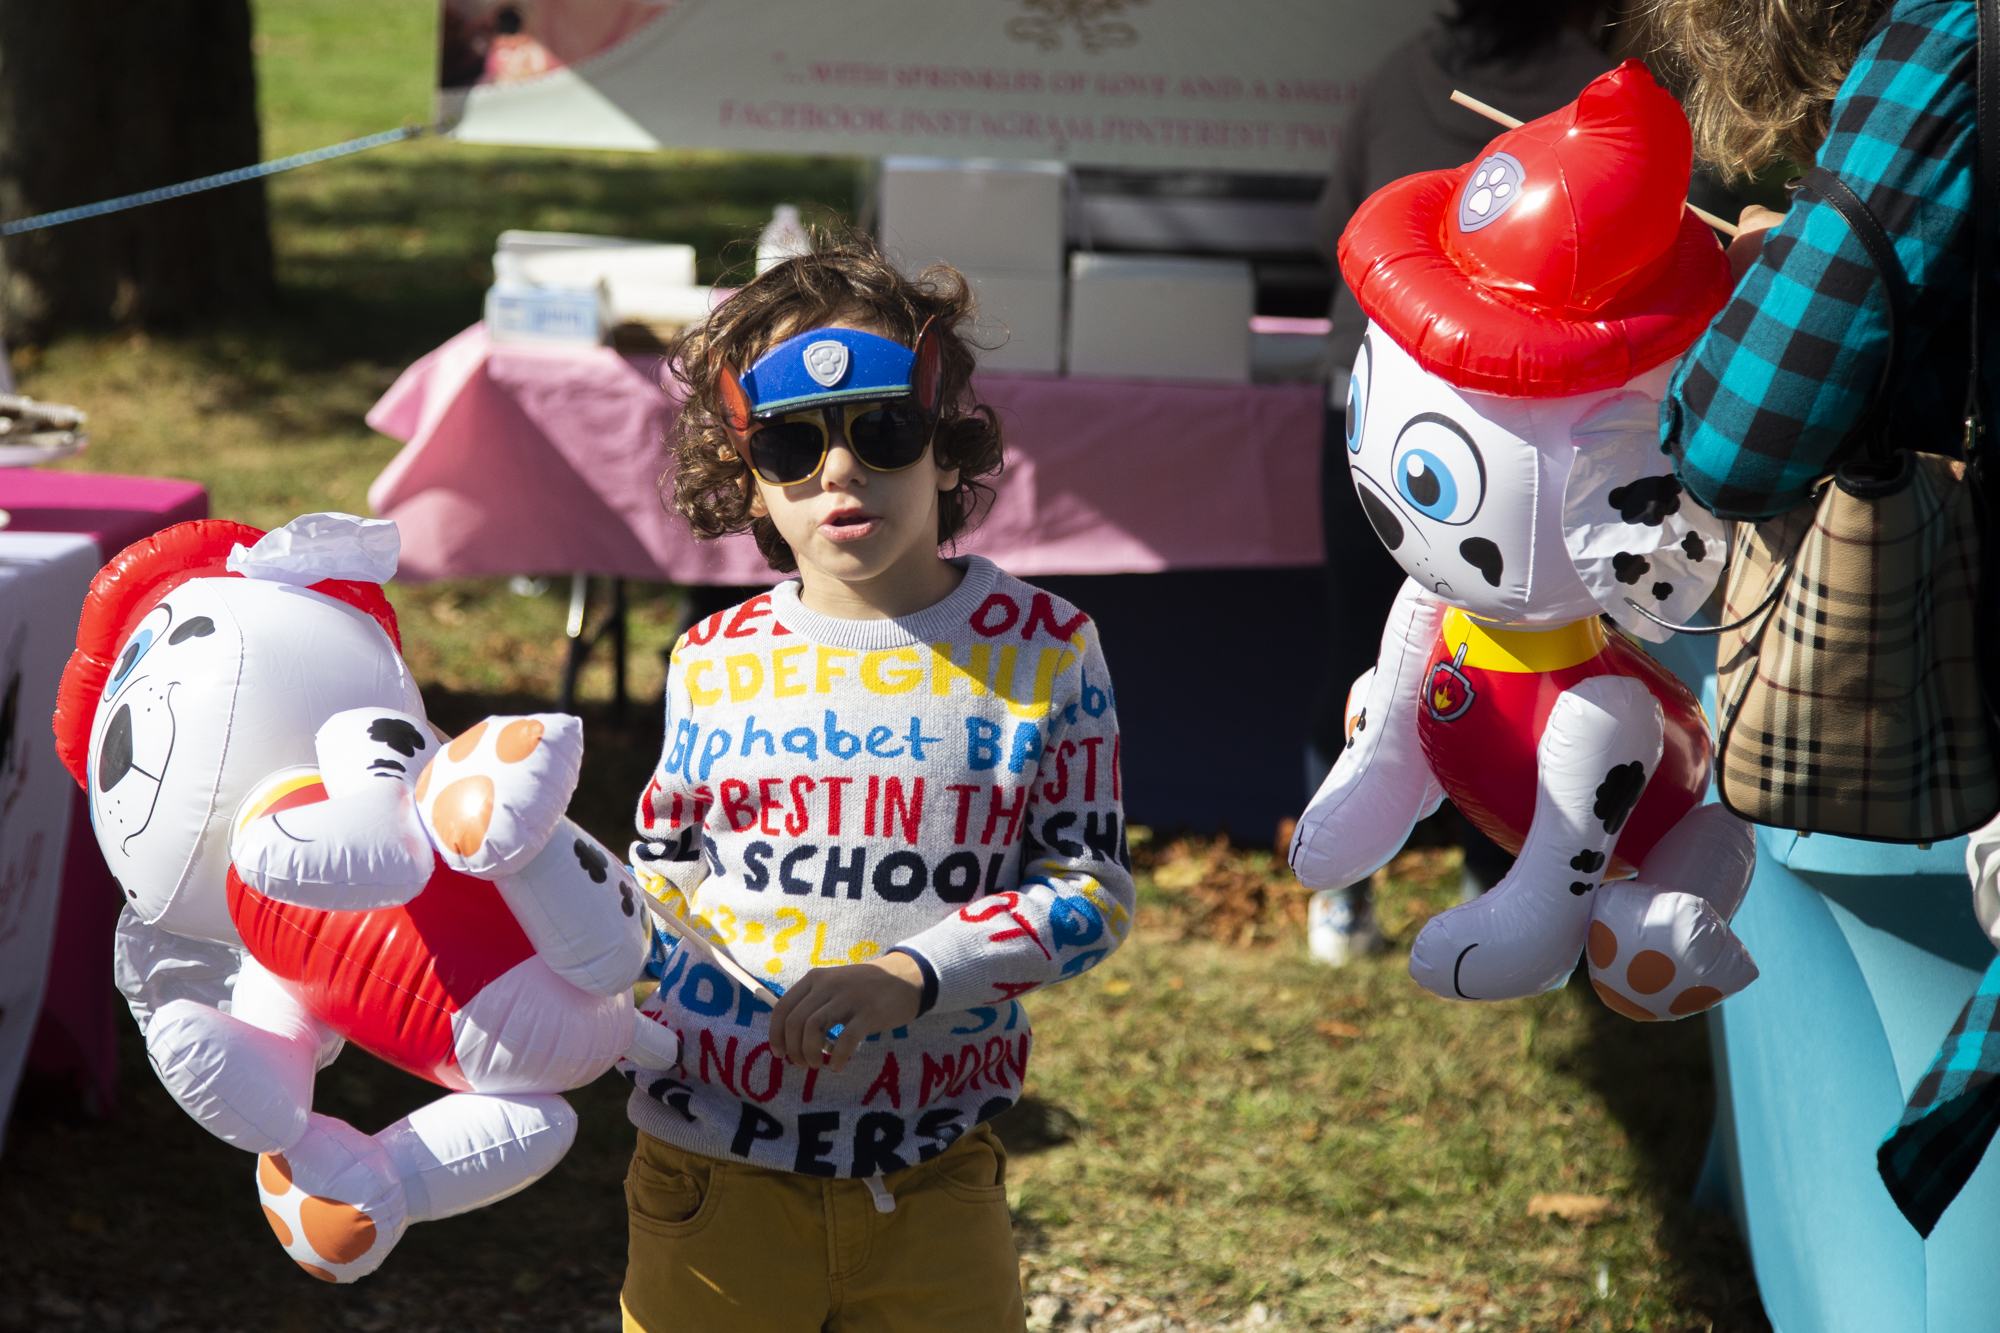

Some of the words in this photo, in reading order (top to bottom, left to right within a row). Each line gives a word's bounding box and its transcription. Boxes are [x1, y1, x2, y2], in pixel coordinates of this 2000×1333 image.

[968, 593, 1091, 642] ON
[720, 775, 852, 838] BEST
[864, 775, 924, 846] IN
[861, 1052, 900, 1109] A
